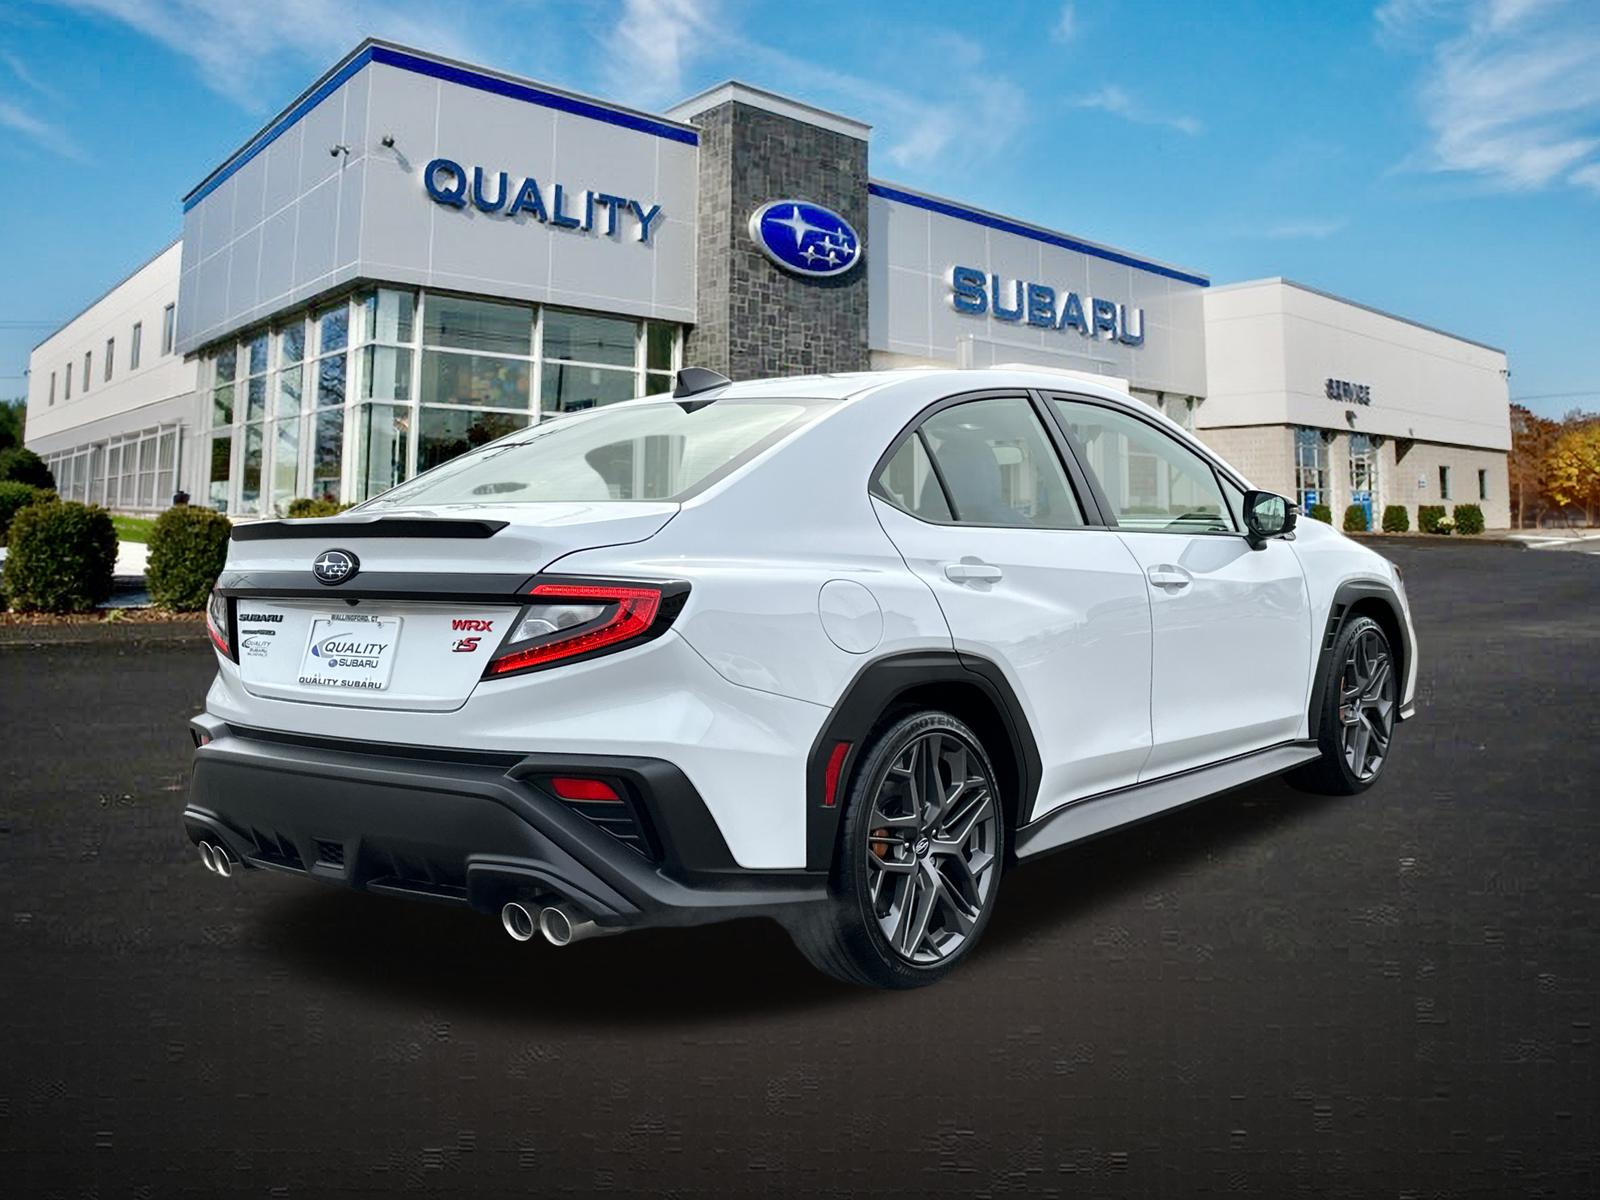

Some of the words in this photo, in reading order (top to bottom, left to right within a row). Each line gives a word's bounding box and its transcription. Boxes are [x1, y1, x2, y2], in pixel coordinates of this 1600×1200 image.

[424, 157, 662, 243] QUALITY
[950, 264, 1146, 348] SUBARU
[239, 613, 284, 623] SUBARU
[452, 619, 494, 632] WRX
[325, 641, 388, 655] QUALITY
[338, 658, 379, 669] SUBARU
[299, 676, 338, 686] QUALITY
[341, 679, 382, 689] SUBARU
